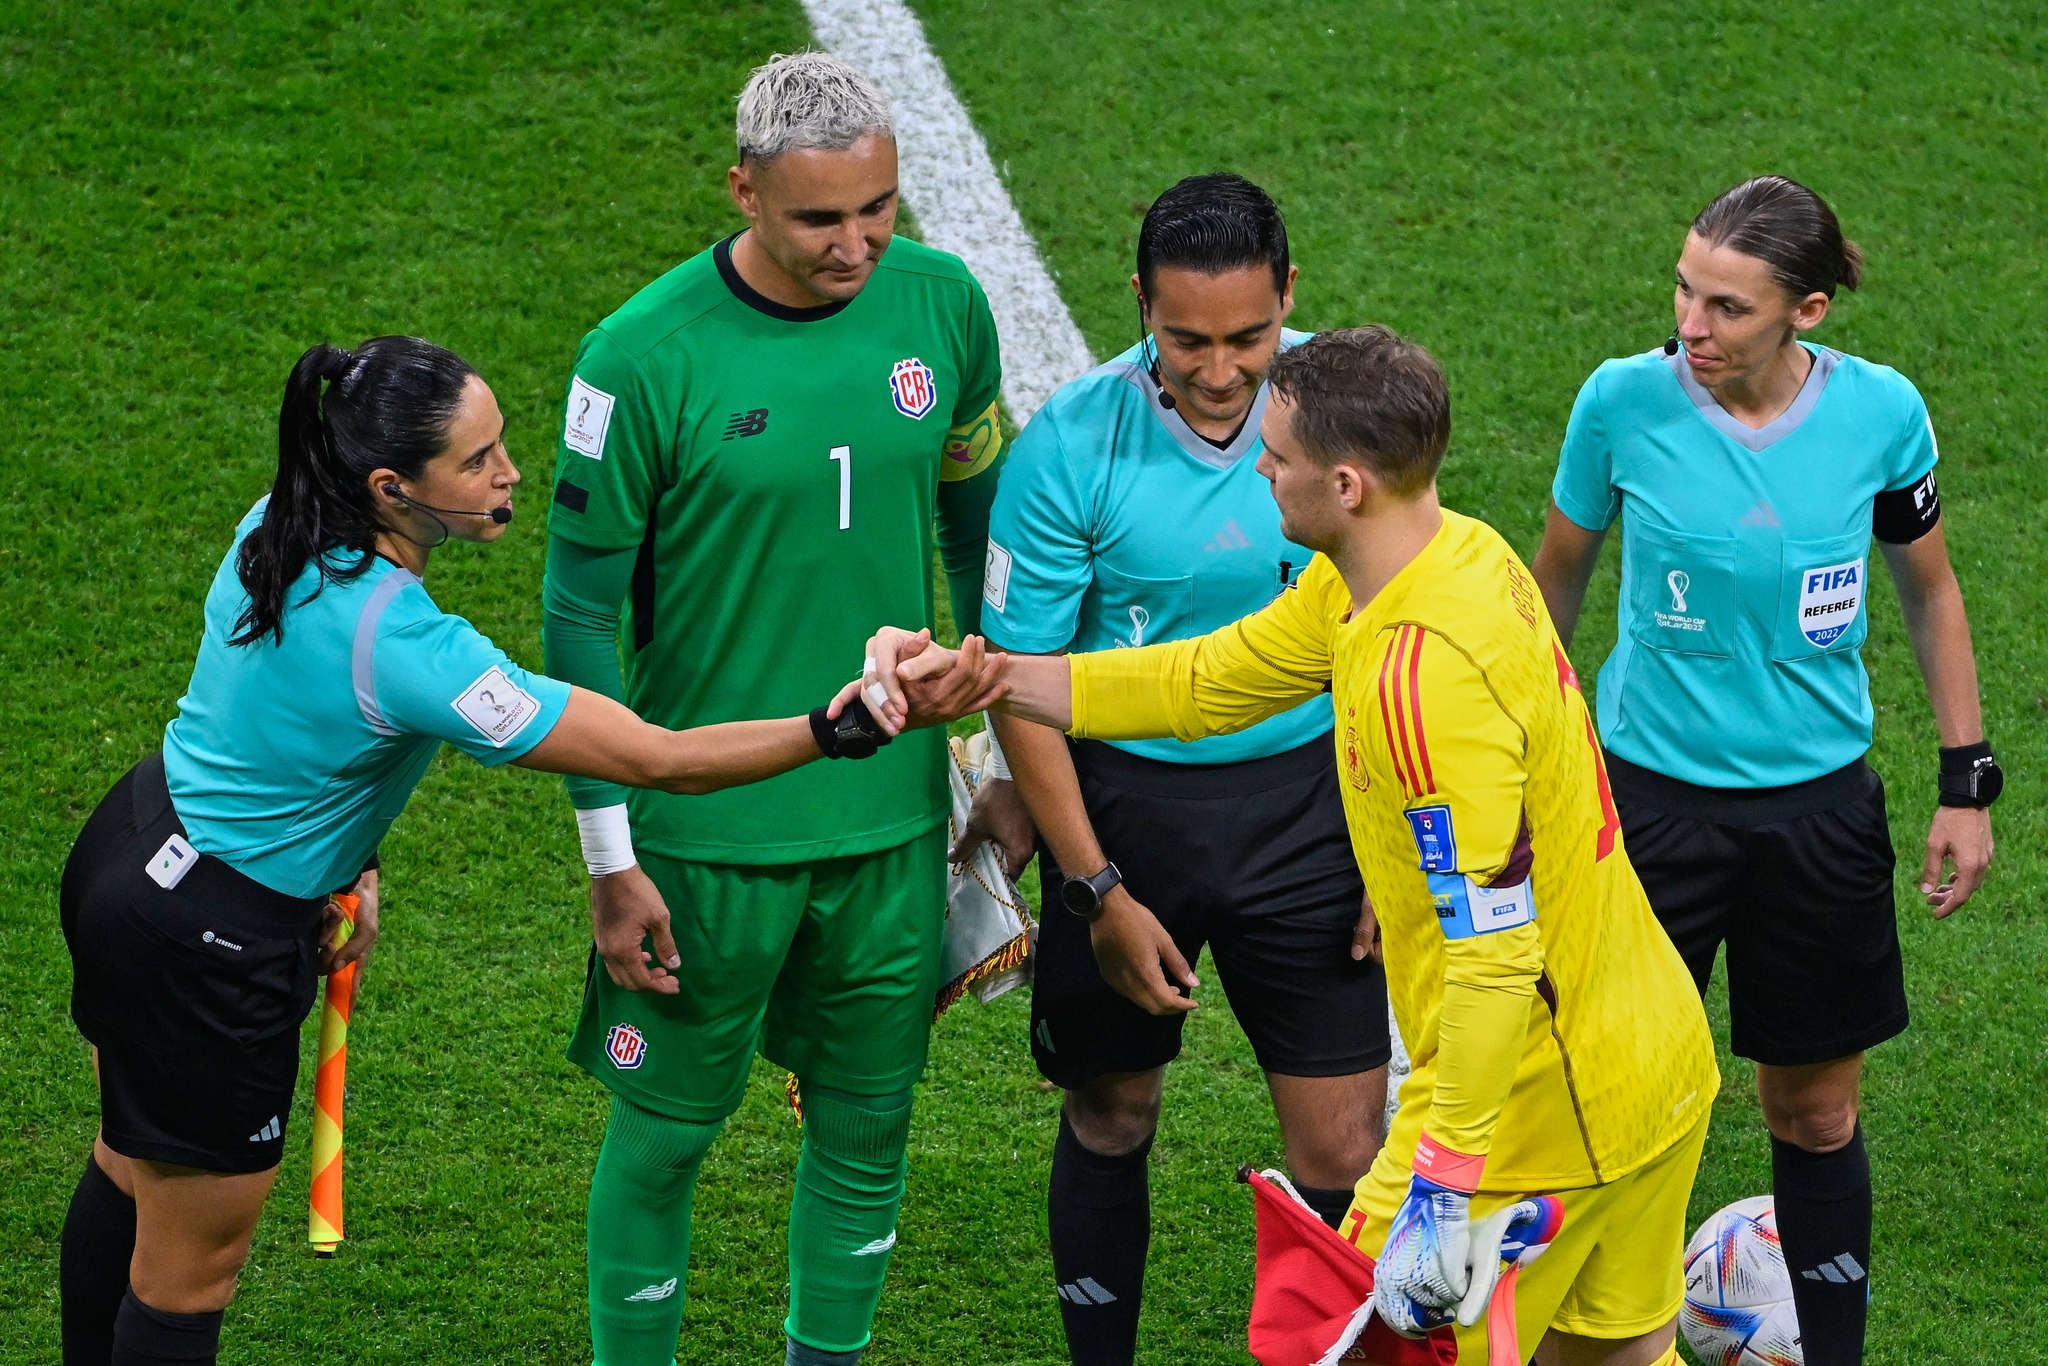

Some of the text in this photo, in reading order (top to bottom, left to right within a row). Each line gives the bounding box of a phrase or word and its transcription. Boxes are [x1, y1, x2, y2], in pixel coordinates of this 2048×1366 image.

[829, 444, 851, 531] 1
[1807, 566, 1857, 594] FIFA
[1804, 597, 1856, 618] REFEREE
[1654, 611, 1668, 620] FIFA
[1668, 615, 1692, 623] WORLD
[1814, 628, 1839, 641] 2022
[1495, 905, 1514, 915] FIFA
